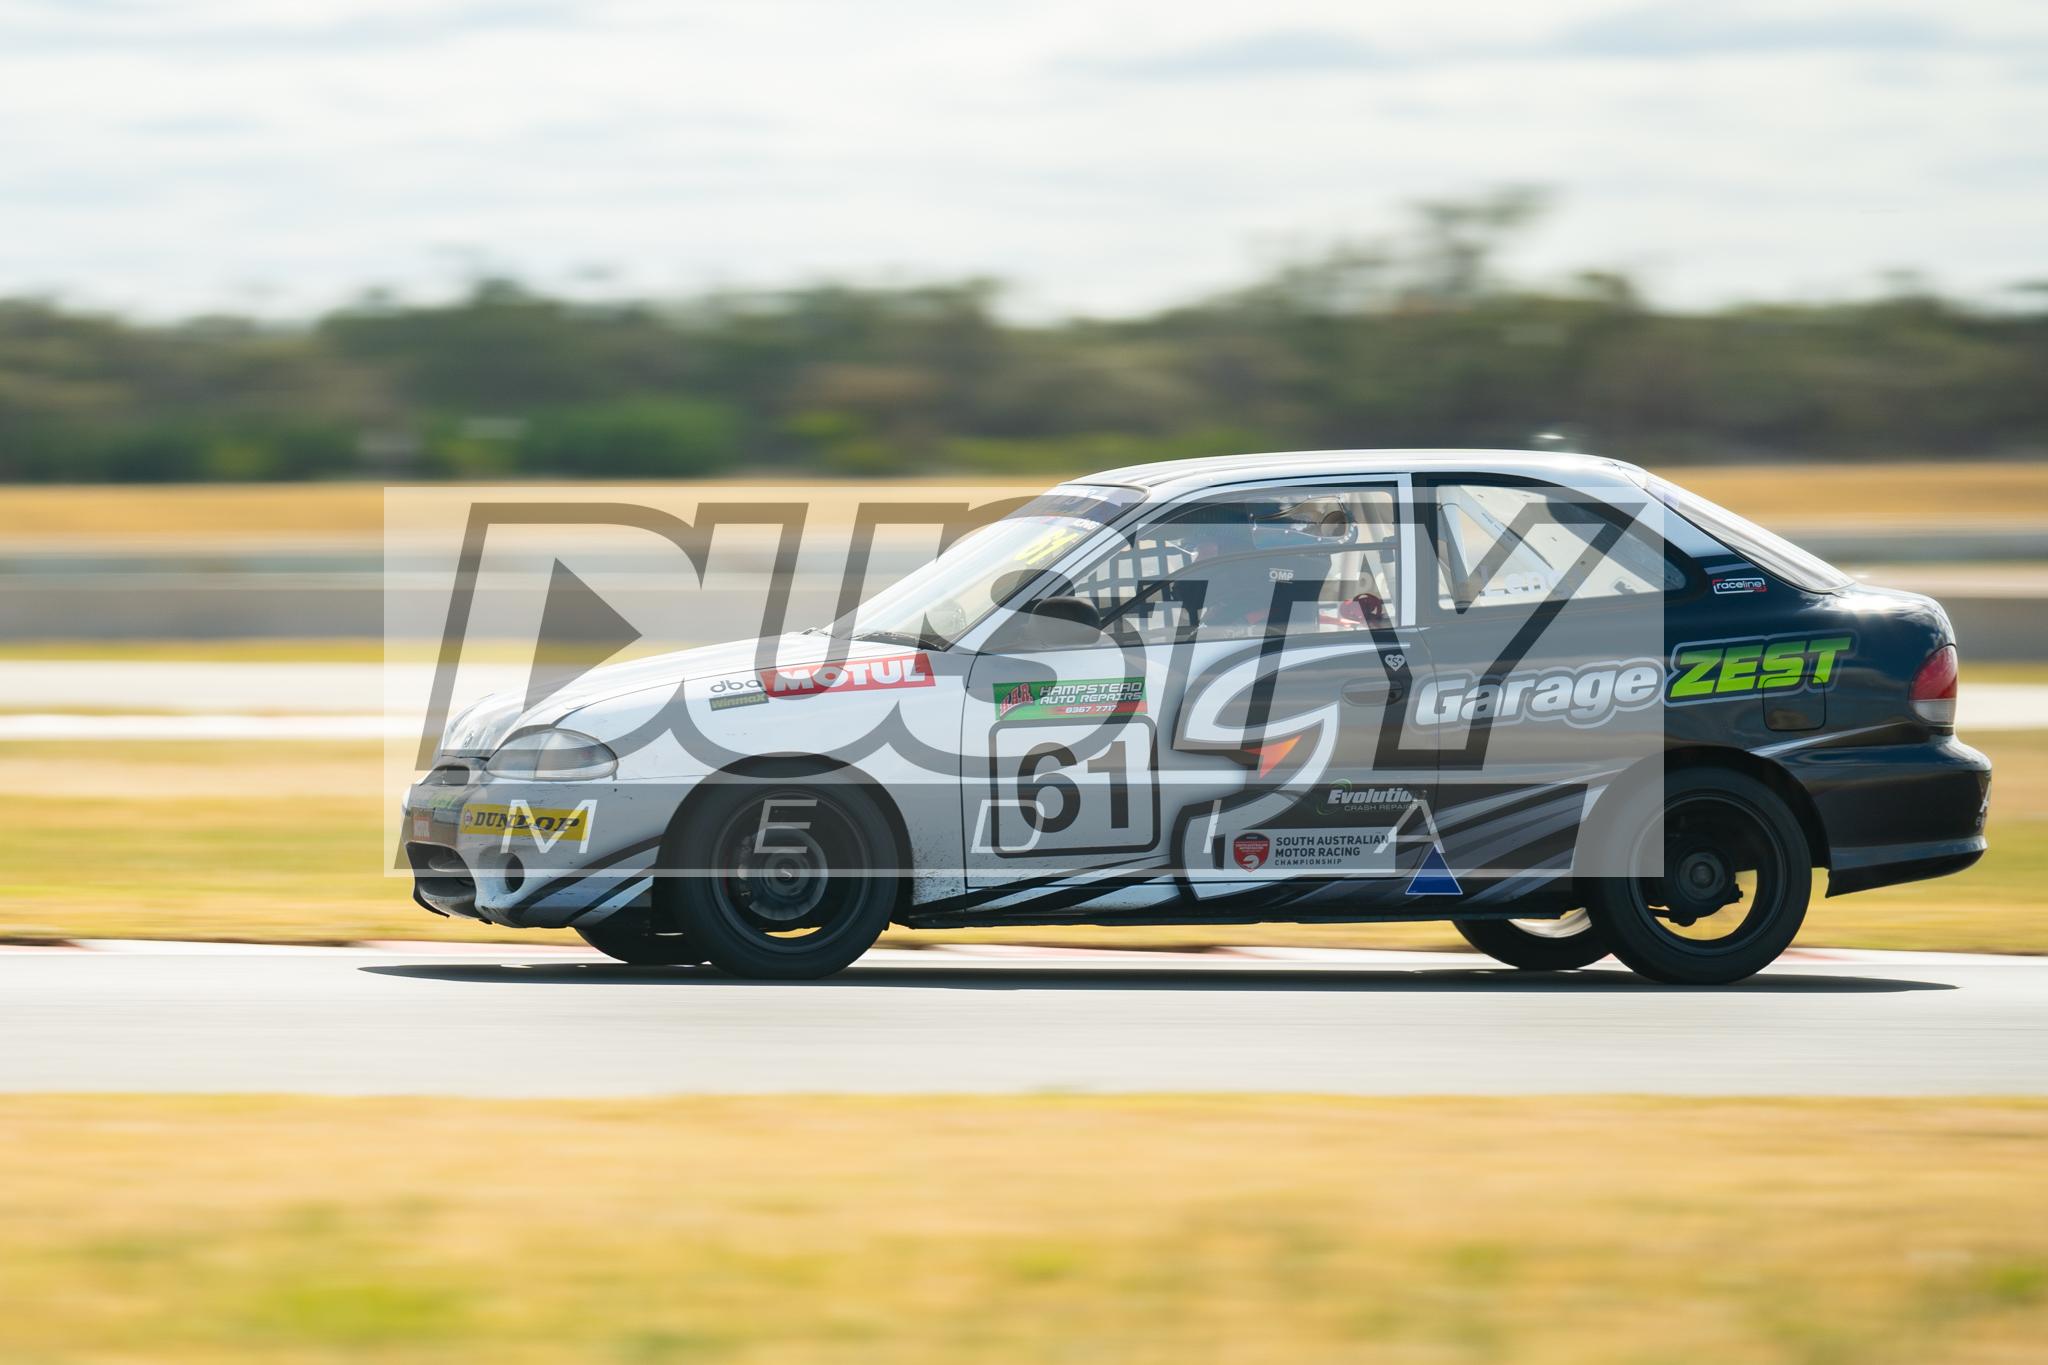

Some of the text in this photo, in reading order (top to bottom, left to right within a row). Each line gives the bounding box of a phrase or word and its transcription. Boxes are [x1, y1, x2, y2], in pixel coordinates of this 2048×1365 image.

[1269, 570, 1294, 581] OMP
[1716, 580, 1762, 590] raceline
[1670, 636, 1852, 699] ZEST
[773, 658, 926, 692] MOTUL
[710, 680, 764, 694] dba
[1040, 682, 1143, 696] HAMPSTEAD
[1040, 692, 1143, 705] AUTO REPAIRS
[1415, 666, 1658, 726] Garage
[1017, 741, 1129, 833] 61
[1344, 804, 1377, 812] CRASH
[473, 811, 581, 832] DUNLOP
[1275, 836, 1315, 847] SOUTH
[1317, 834, 1390, 846] AUSTRALIAN
[1275, 846, 1361, 858] MOTOR RACING
[1274, 858, 1343, 866] CHAMPIONSHIP
